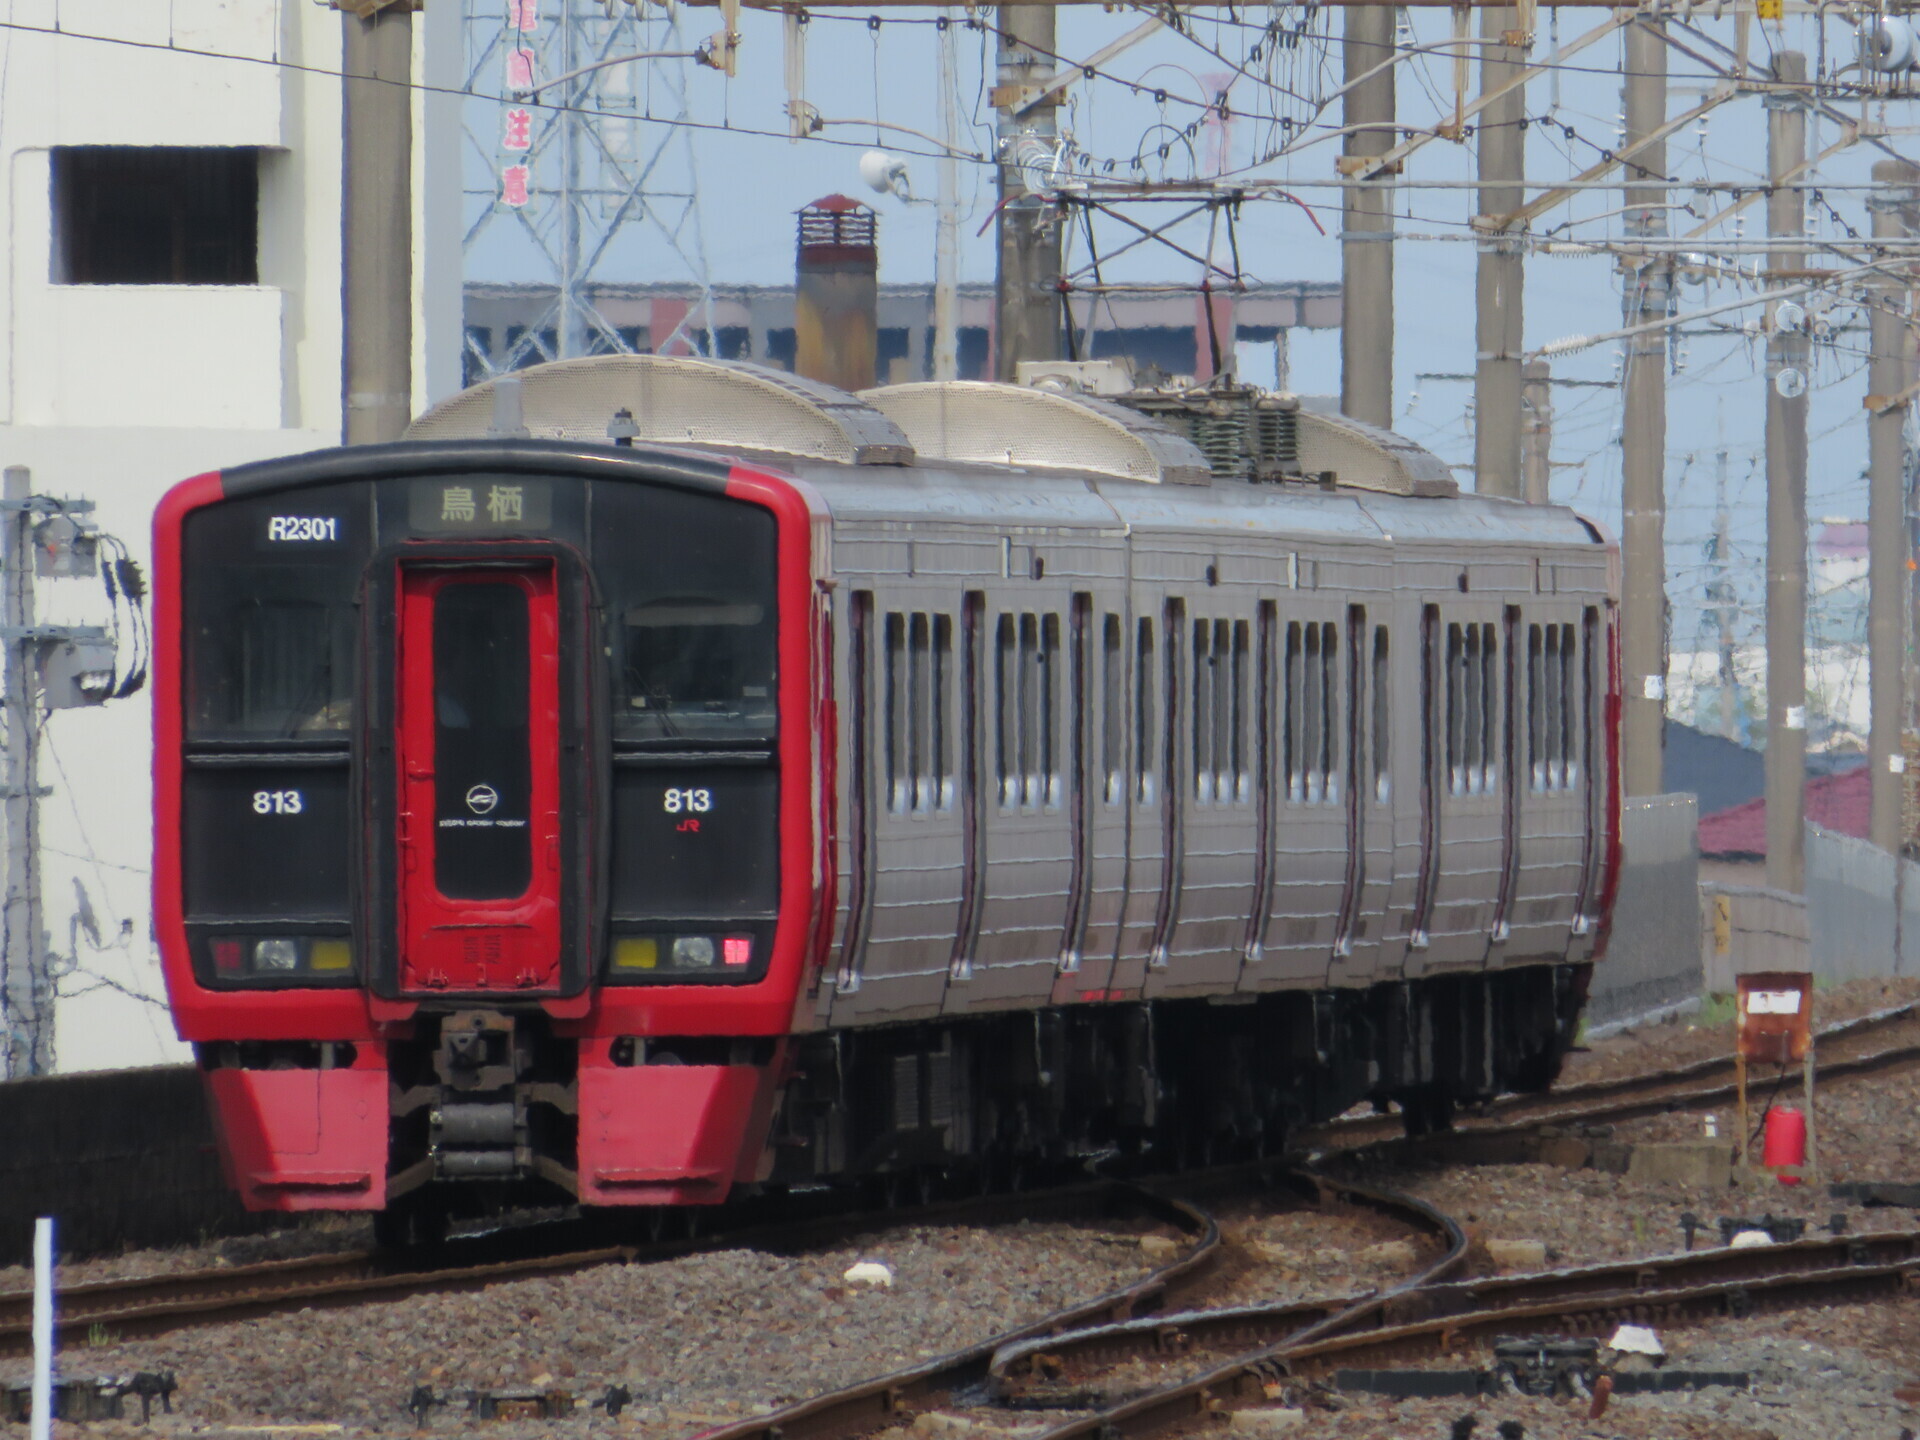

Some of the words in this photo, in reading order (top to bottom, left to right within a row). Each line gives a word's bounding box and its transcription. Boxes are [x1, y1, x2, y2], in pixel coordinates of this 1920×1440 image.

[441, 485, 522, 522] 鳥栖
[268, 516, 336, 541] R2301
[253, 791, 302, 814] 813
[664, 788, 710, 813] 813
[676, 819, 700, 832] JR
